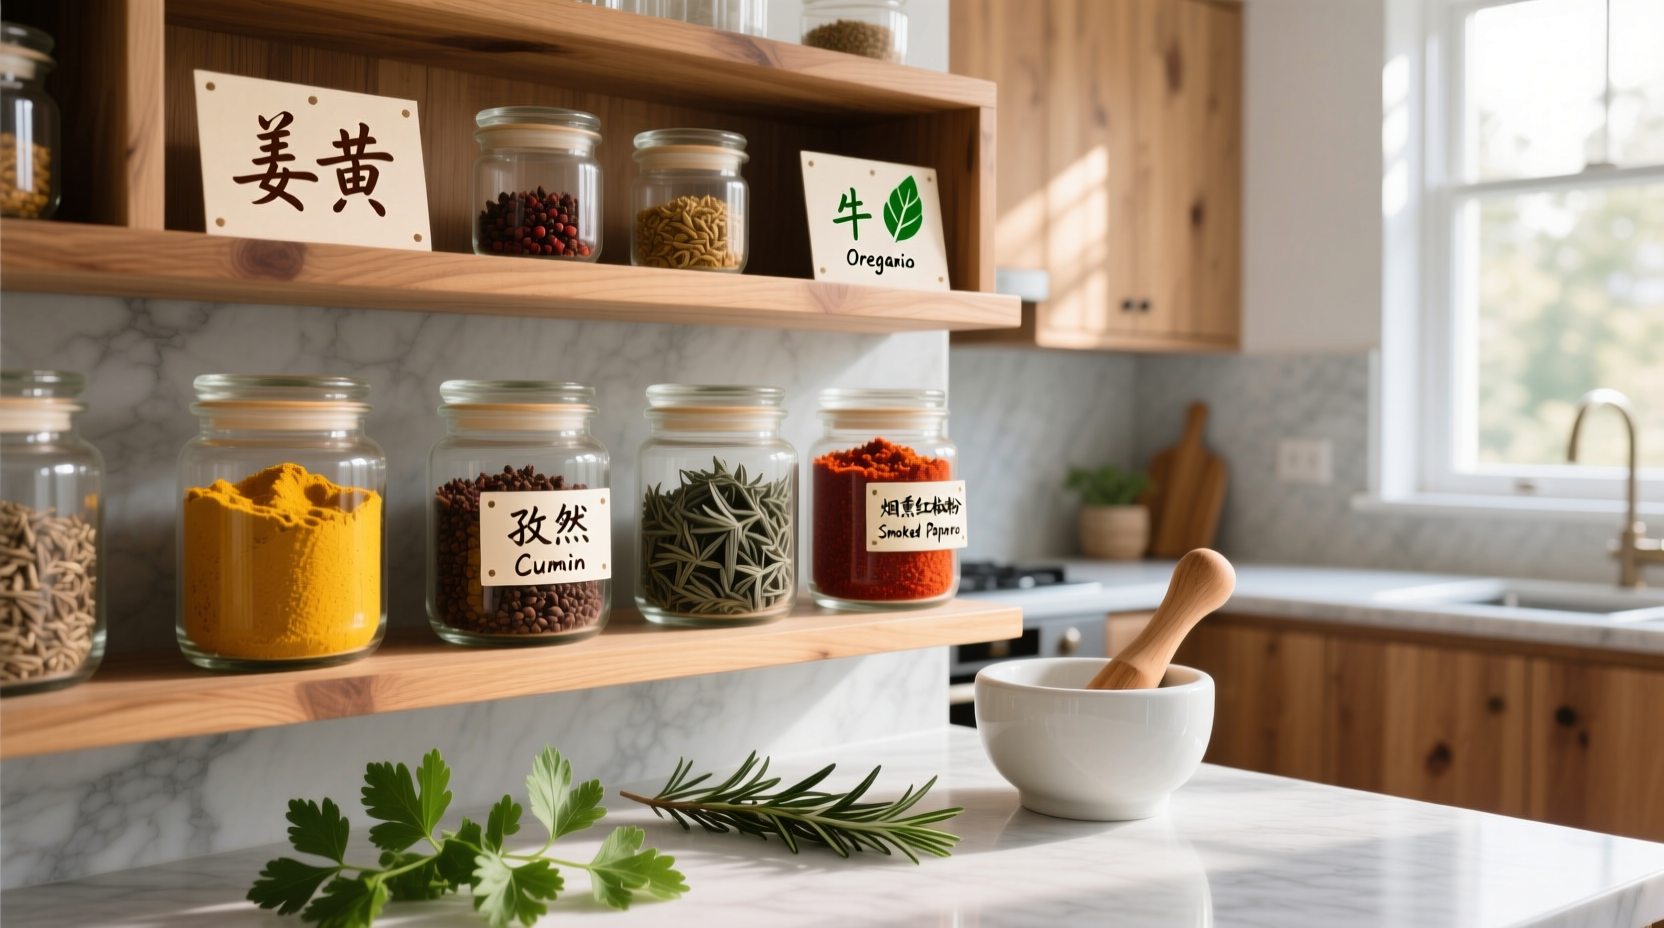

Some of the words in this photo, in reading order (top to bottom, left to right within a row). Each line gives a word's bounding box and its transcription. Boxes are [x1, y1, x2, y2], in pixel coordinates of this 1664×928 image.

[232, 110, 394, 218] 姜黄
[832, 187, 873, 241] 牛
[507, 503, 590, 547] 孜然
[877, 523, 921, 540] Smoked
[514, 552, 585, 577] Cumin
